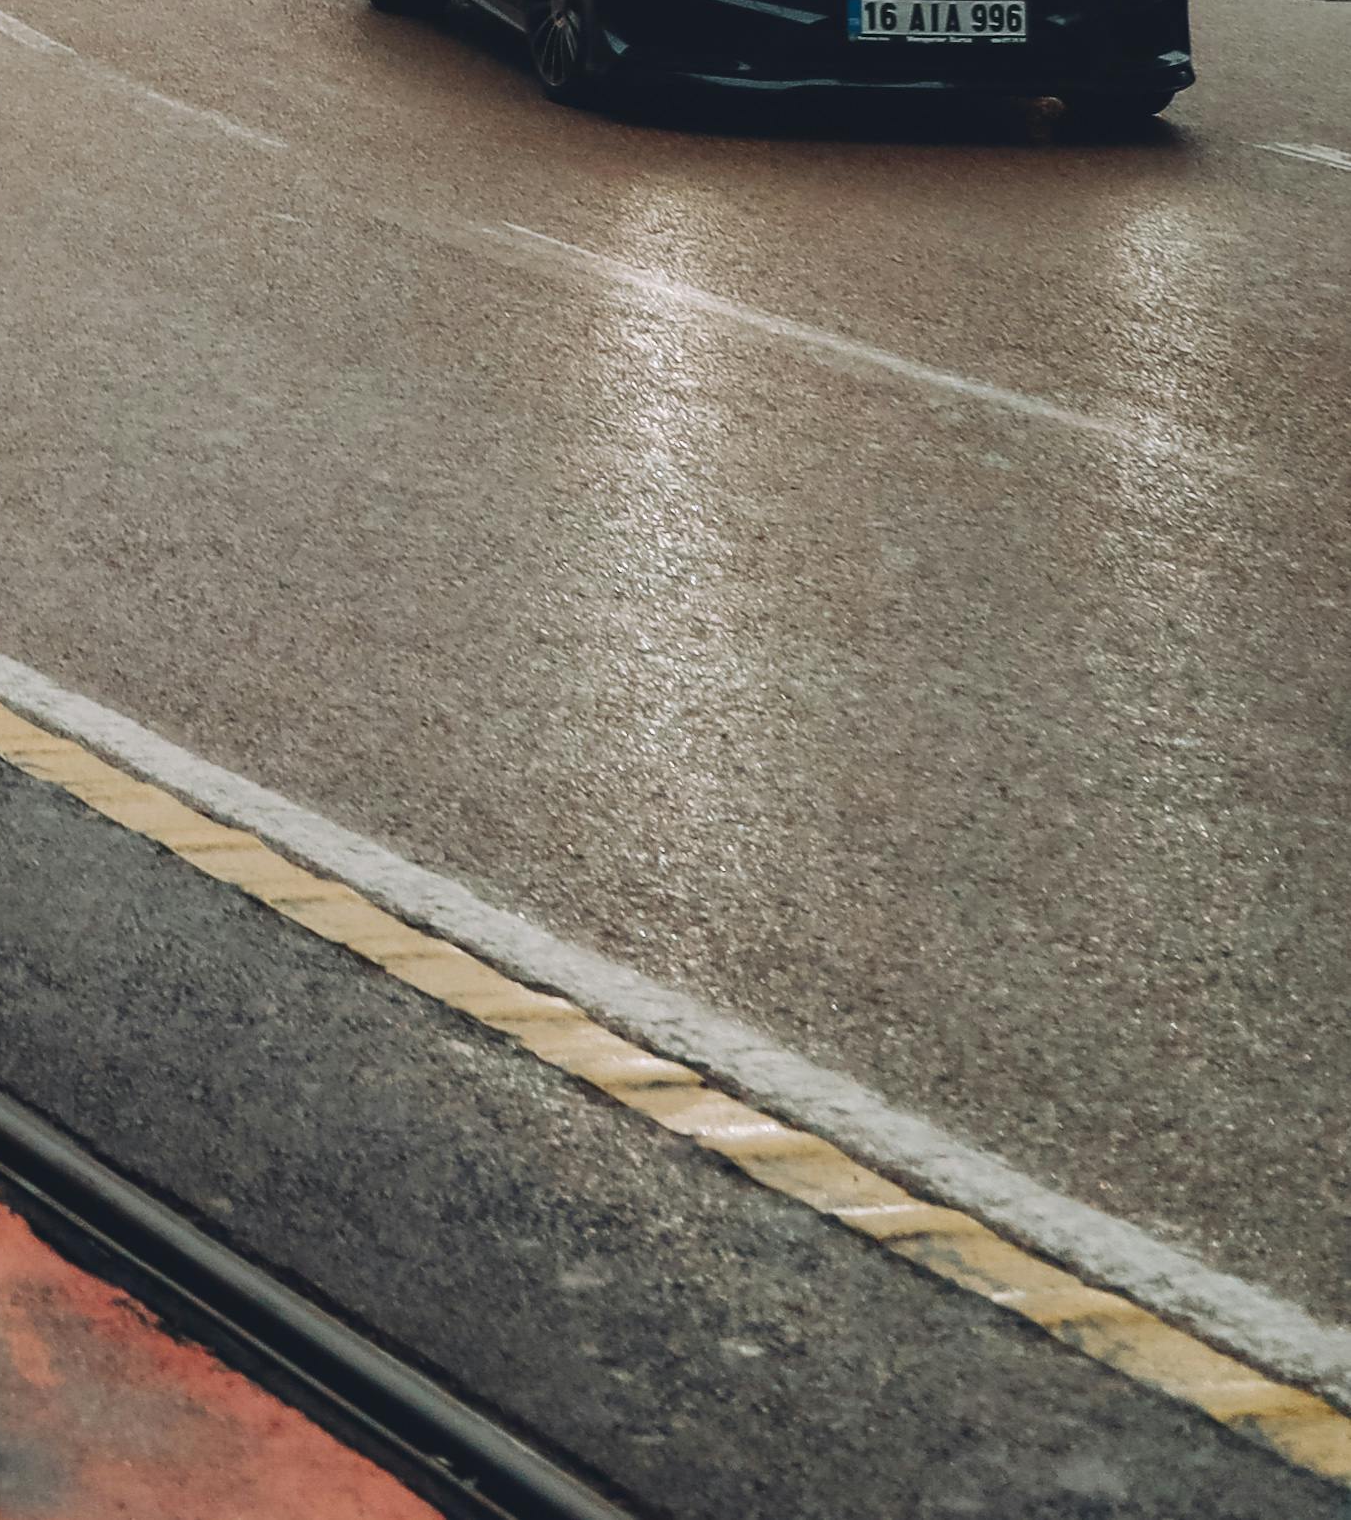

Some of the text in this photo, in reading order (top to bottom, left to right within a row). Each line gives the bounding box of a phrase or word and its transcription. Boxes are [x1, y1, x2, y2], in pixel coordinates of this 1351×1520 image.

[864, 1, 1023, 33] 16 AIA 996
